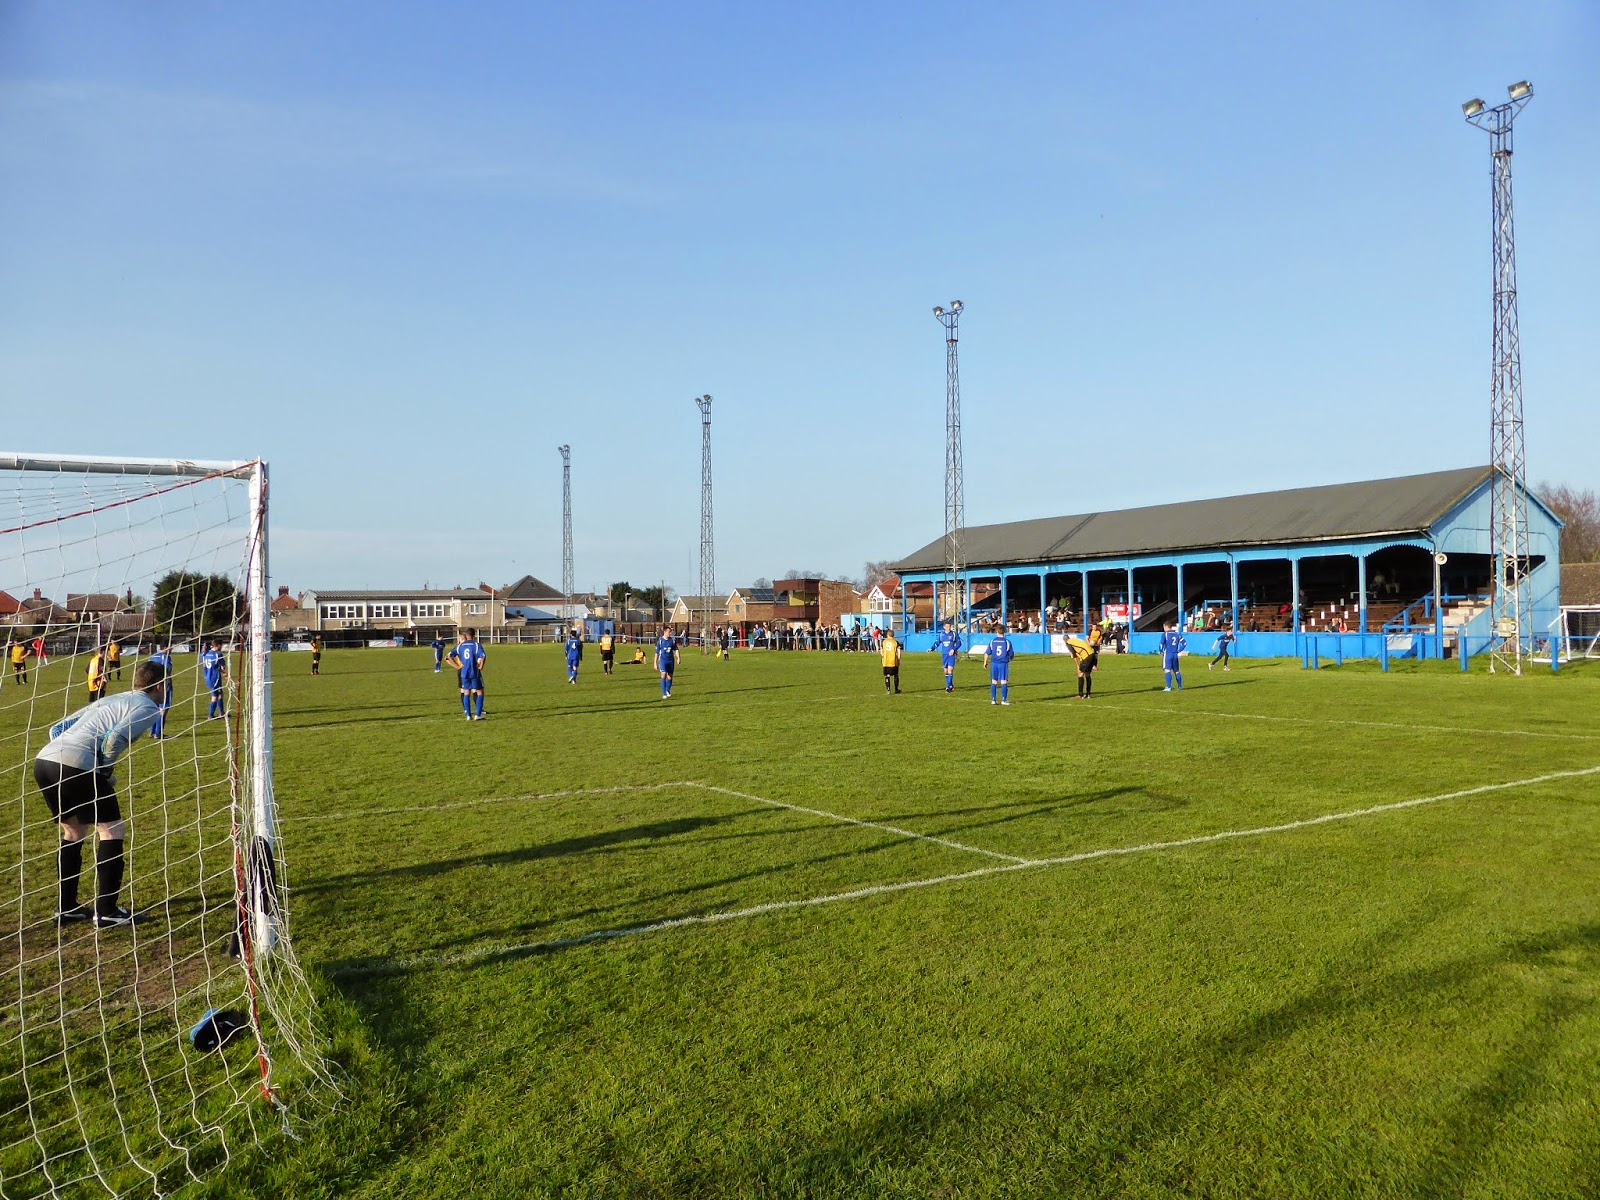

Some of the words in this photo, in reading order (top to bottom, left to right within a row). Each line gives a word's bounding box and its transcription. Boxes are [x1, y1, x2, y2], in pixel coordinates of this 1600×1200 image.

[886, 641, 893, 651] 9
[1171, 636, 1177, 646] 2
[464, 648, 470, 659] 6
[996, 645, 1002, 656] 5
